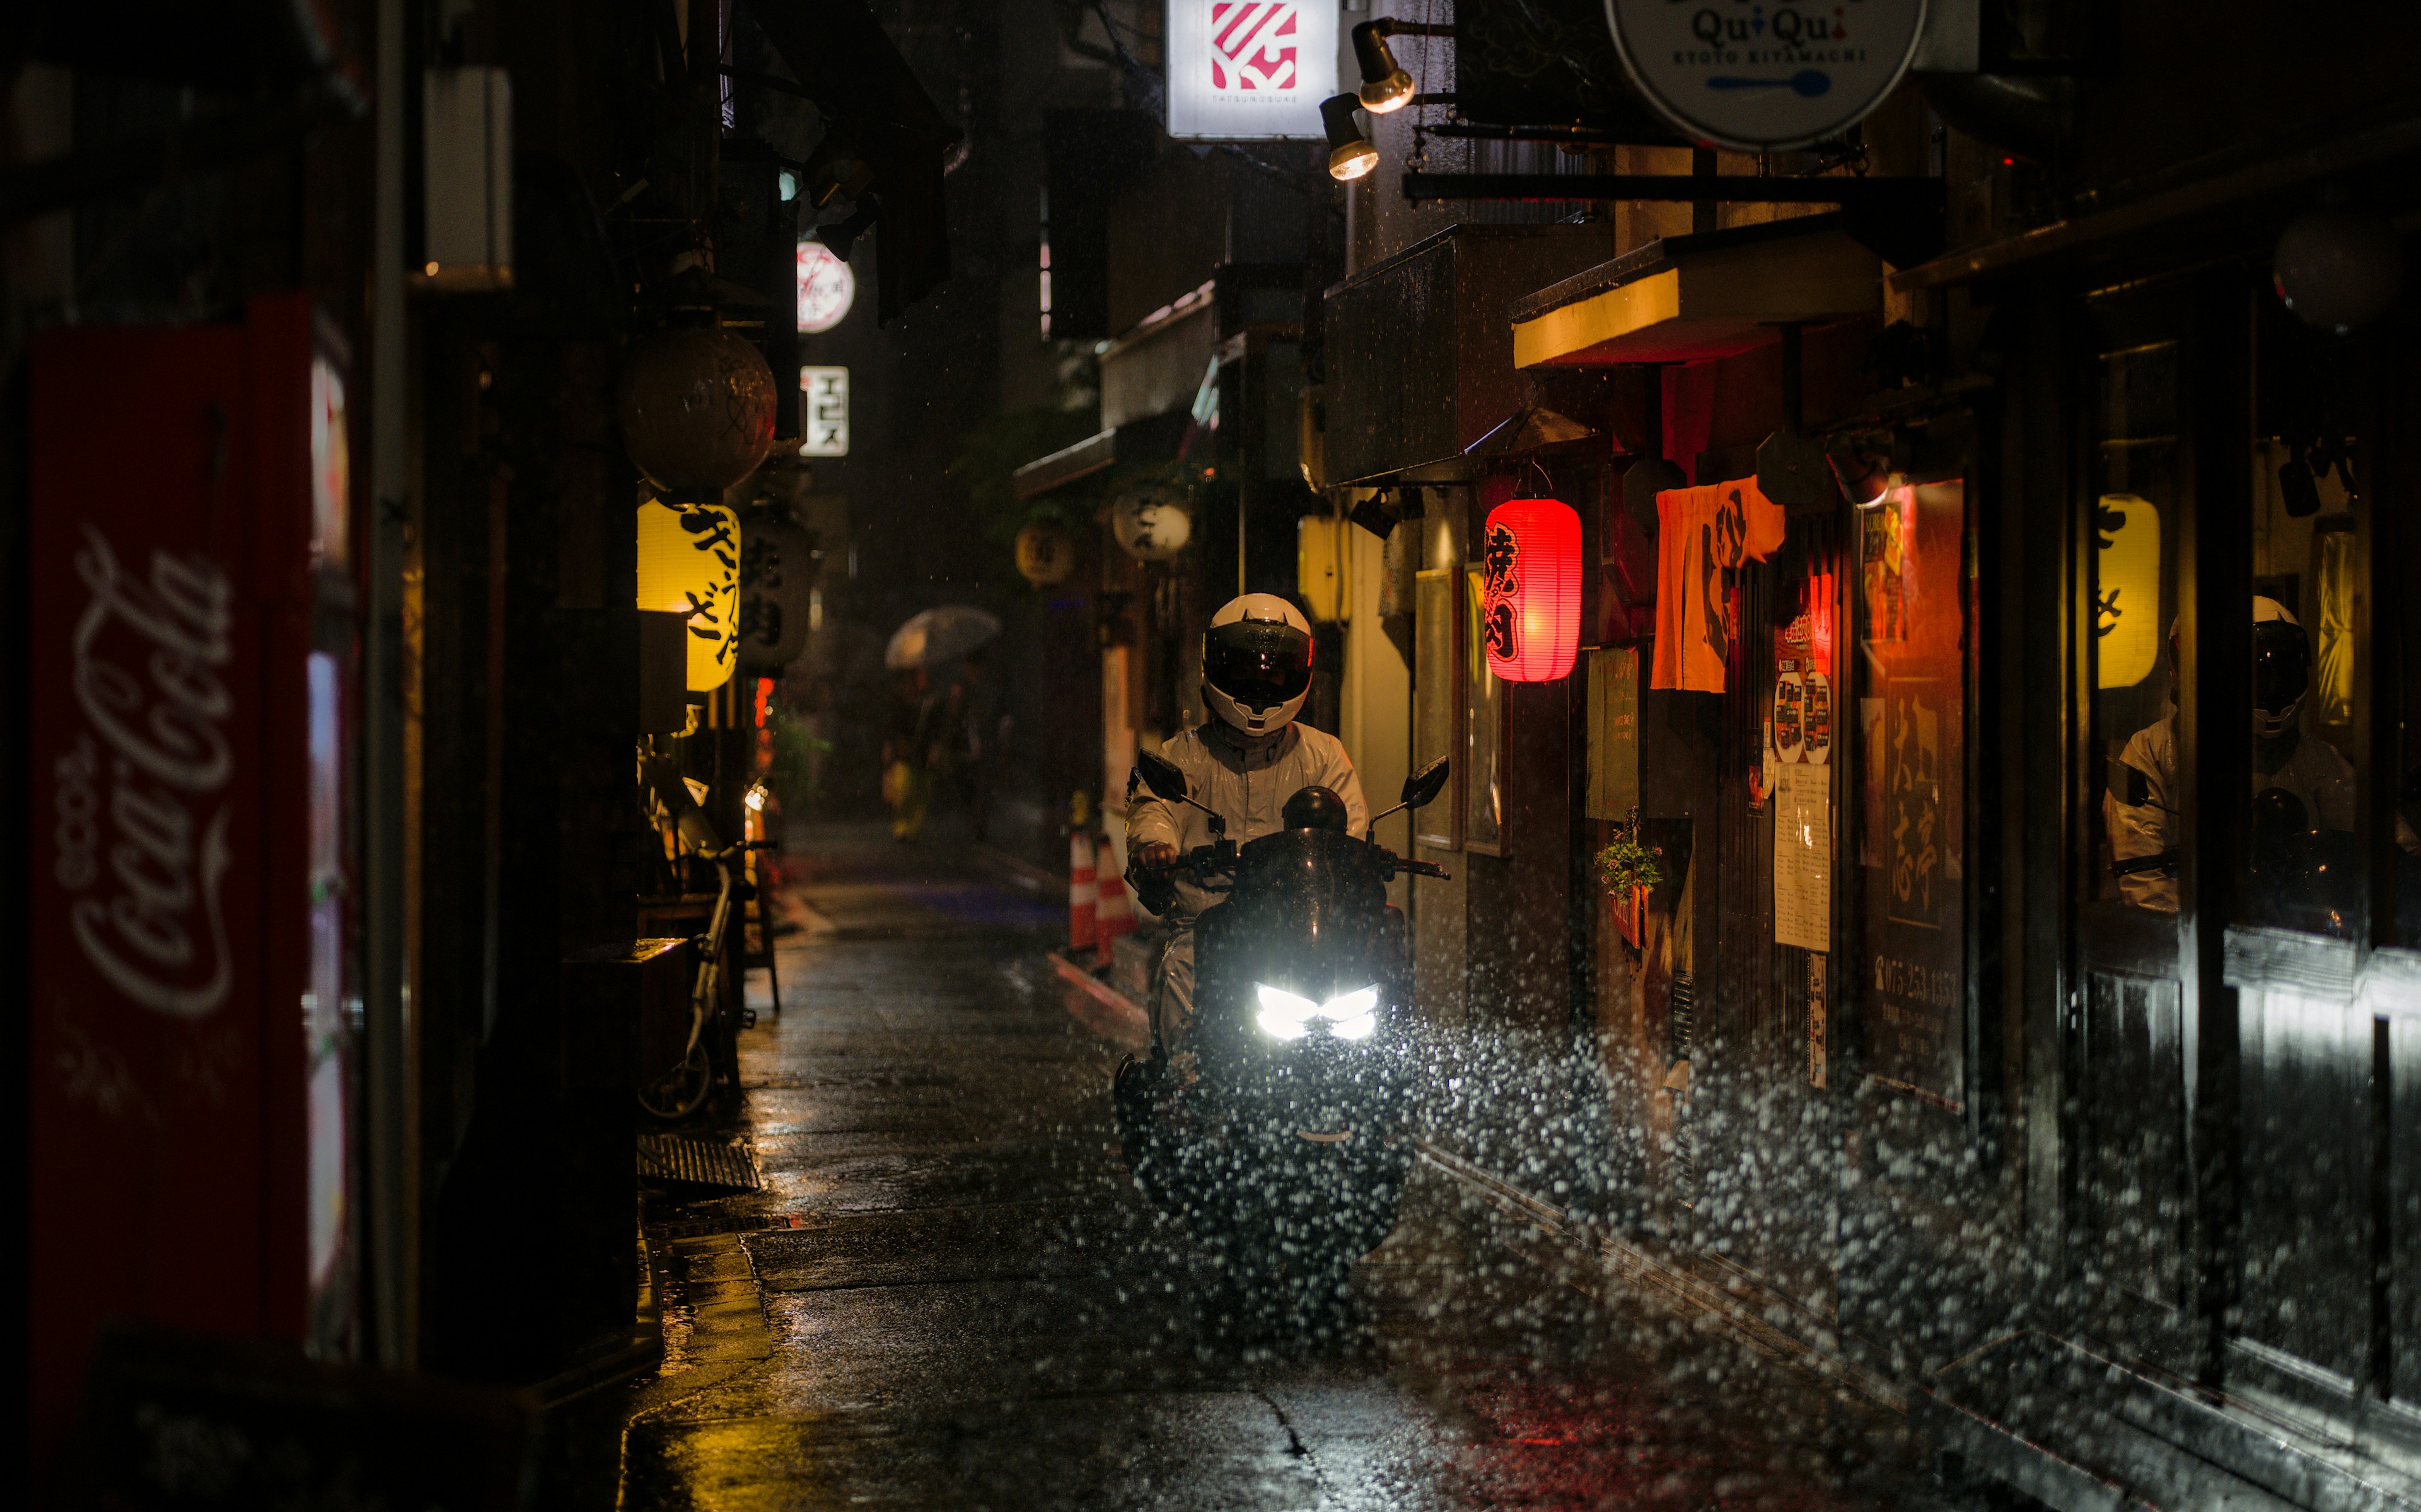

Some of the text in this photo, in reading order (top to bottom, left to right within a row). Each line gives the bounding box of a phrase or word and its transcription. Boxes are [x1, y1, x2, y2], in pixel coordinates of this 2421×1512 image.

[1674, 48, 1866, 64] KYOTO KIYAMACHI
[1483, 524, 1519, 661] 焼肉
[71, 520, 233, 1019] Coca-Cola
